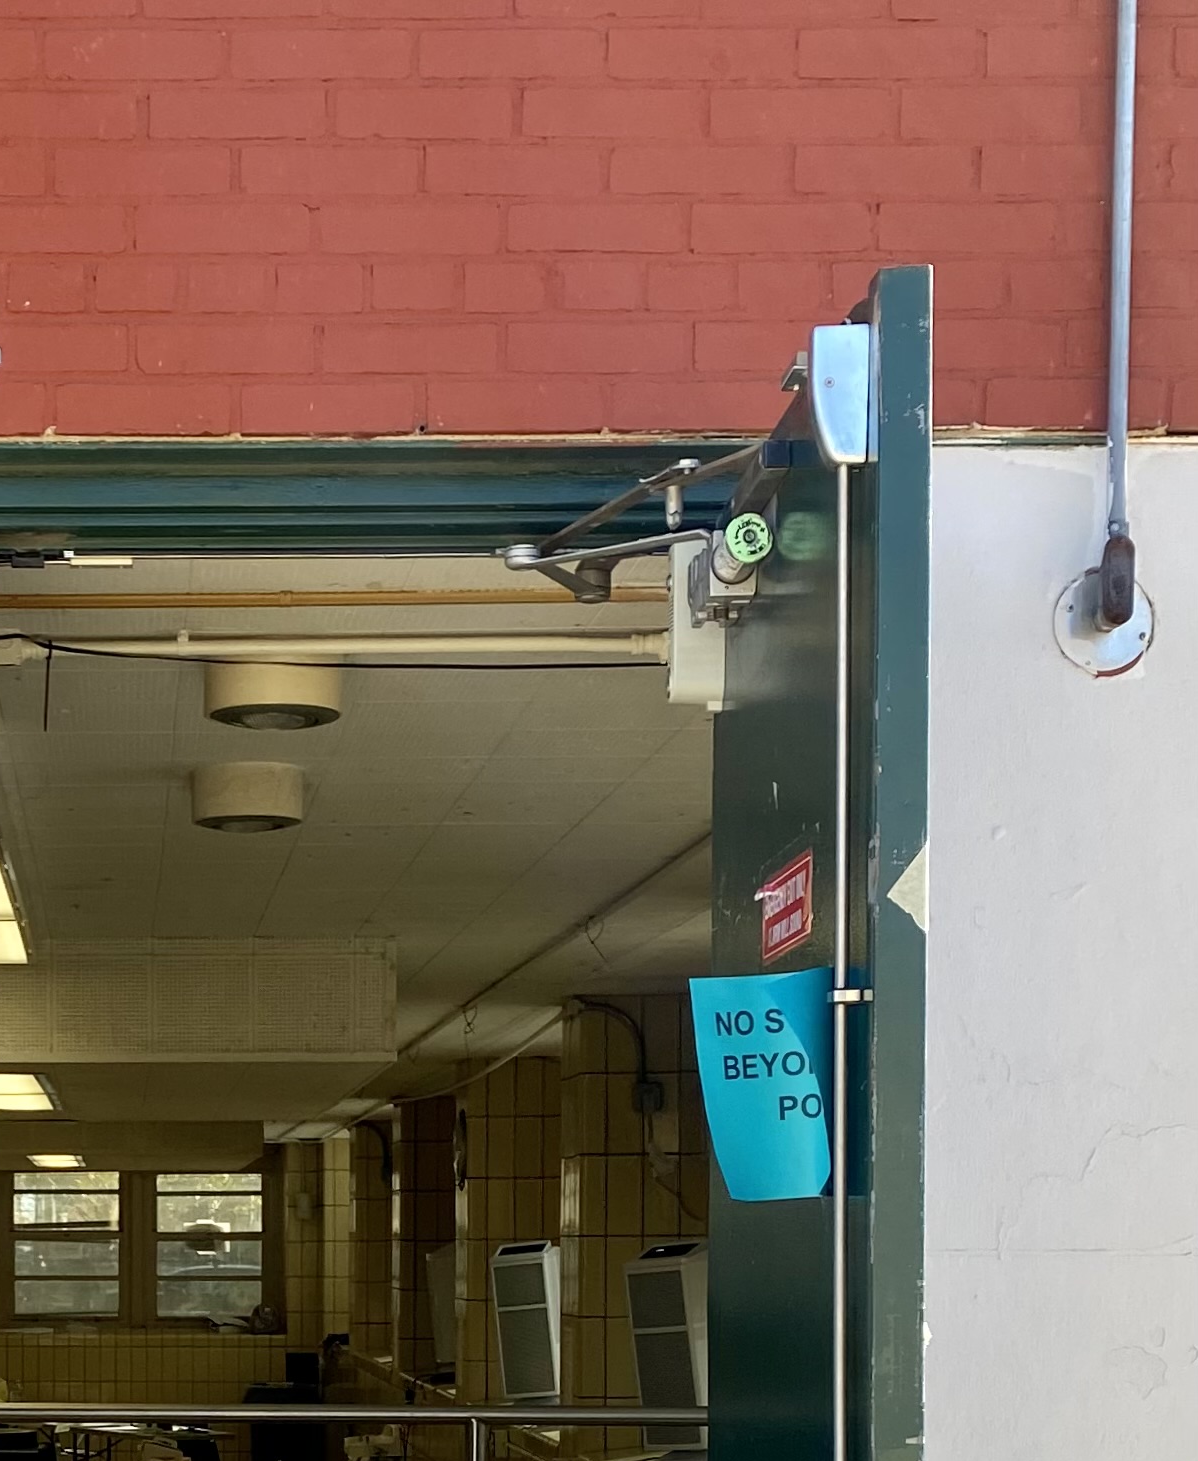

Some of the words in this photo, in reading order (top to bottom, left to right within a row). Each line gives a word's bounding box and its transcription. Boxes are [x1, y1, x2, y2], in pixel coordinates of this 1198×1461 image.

[715, 1010, 754, 1036] NO
[723, 1051, 815, 1080] BEYO
[778, 1093, 822, 1121] PO
